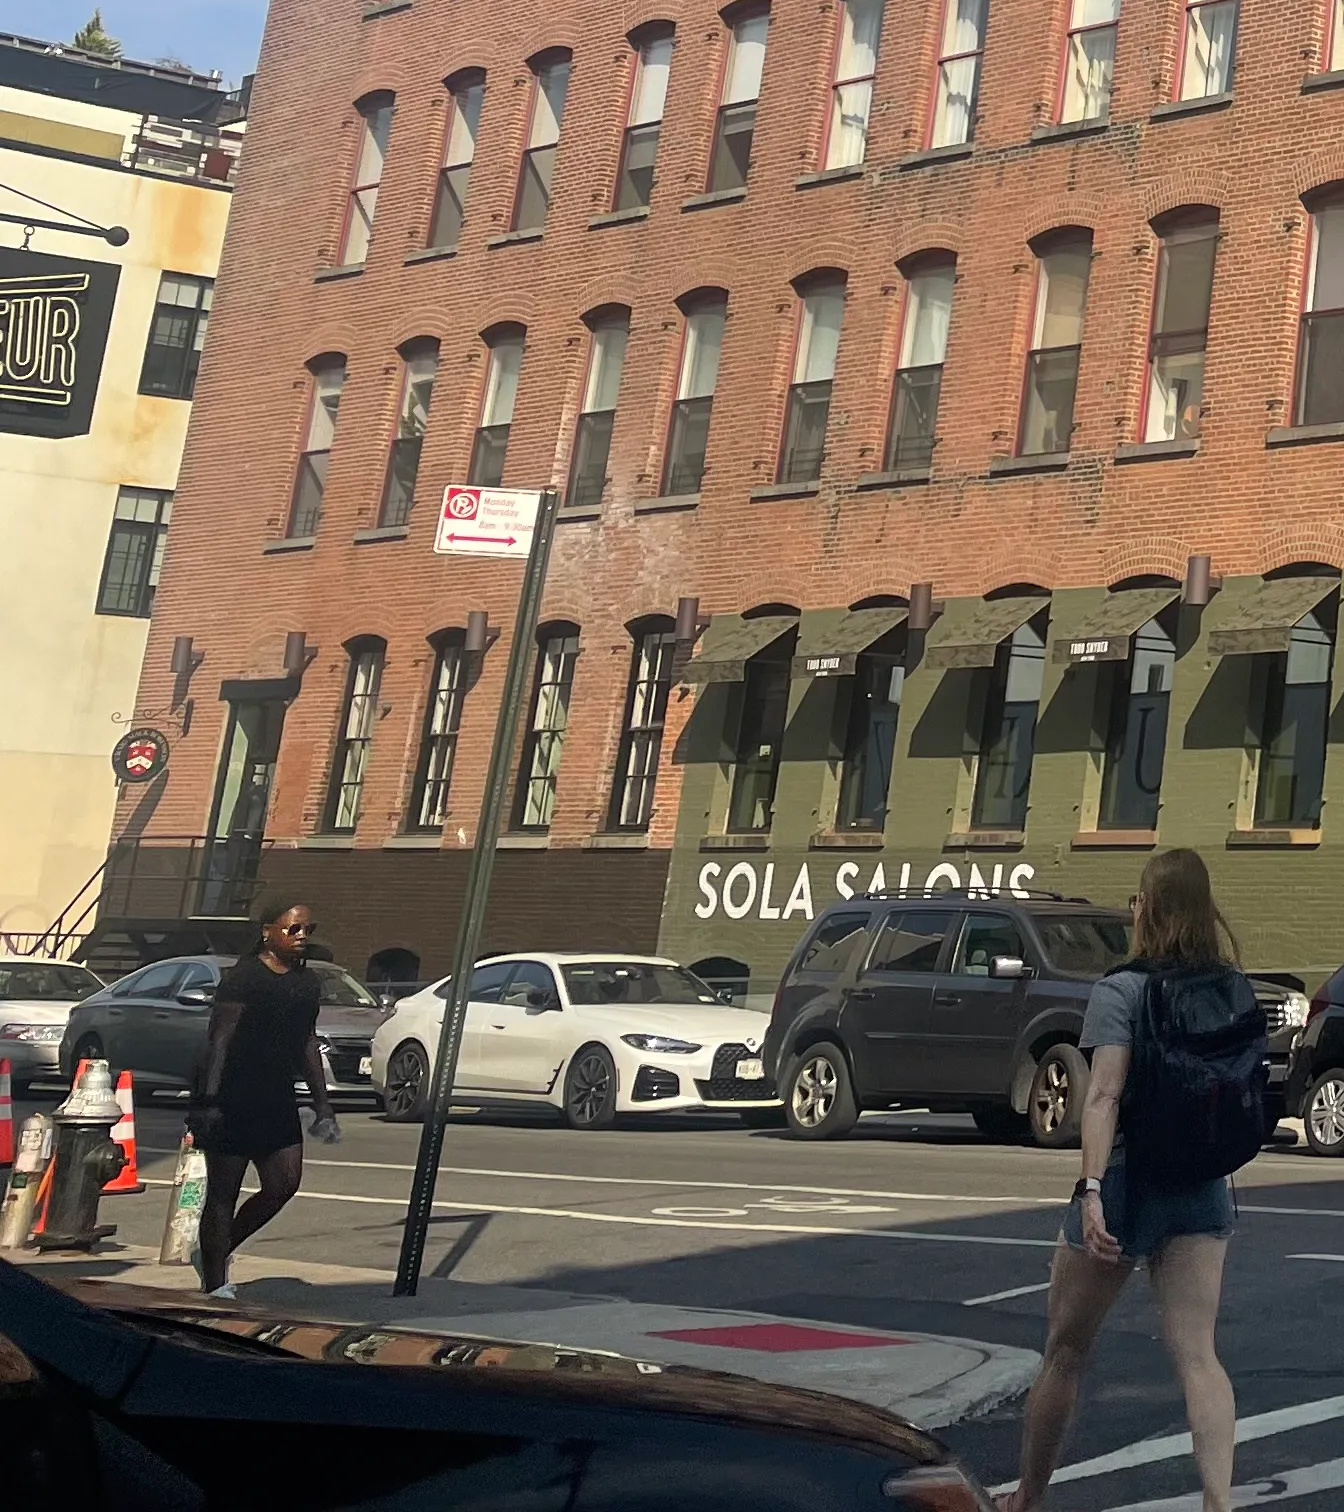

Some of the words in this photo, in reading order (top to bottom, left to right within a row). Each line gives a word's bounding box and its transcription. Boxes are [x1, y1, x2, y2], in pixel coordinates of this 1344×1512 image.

[0, 296, 80, 386] UR
[694, 861, 815, 920] SOLA
[835, 861, 1035, 901] SALONS
